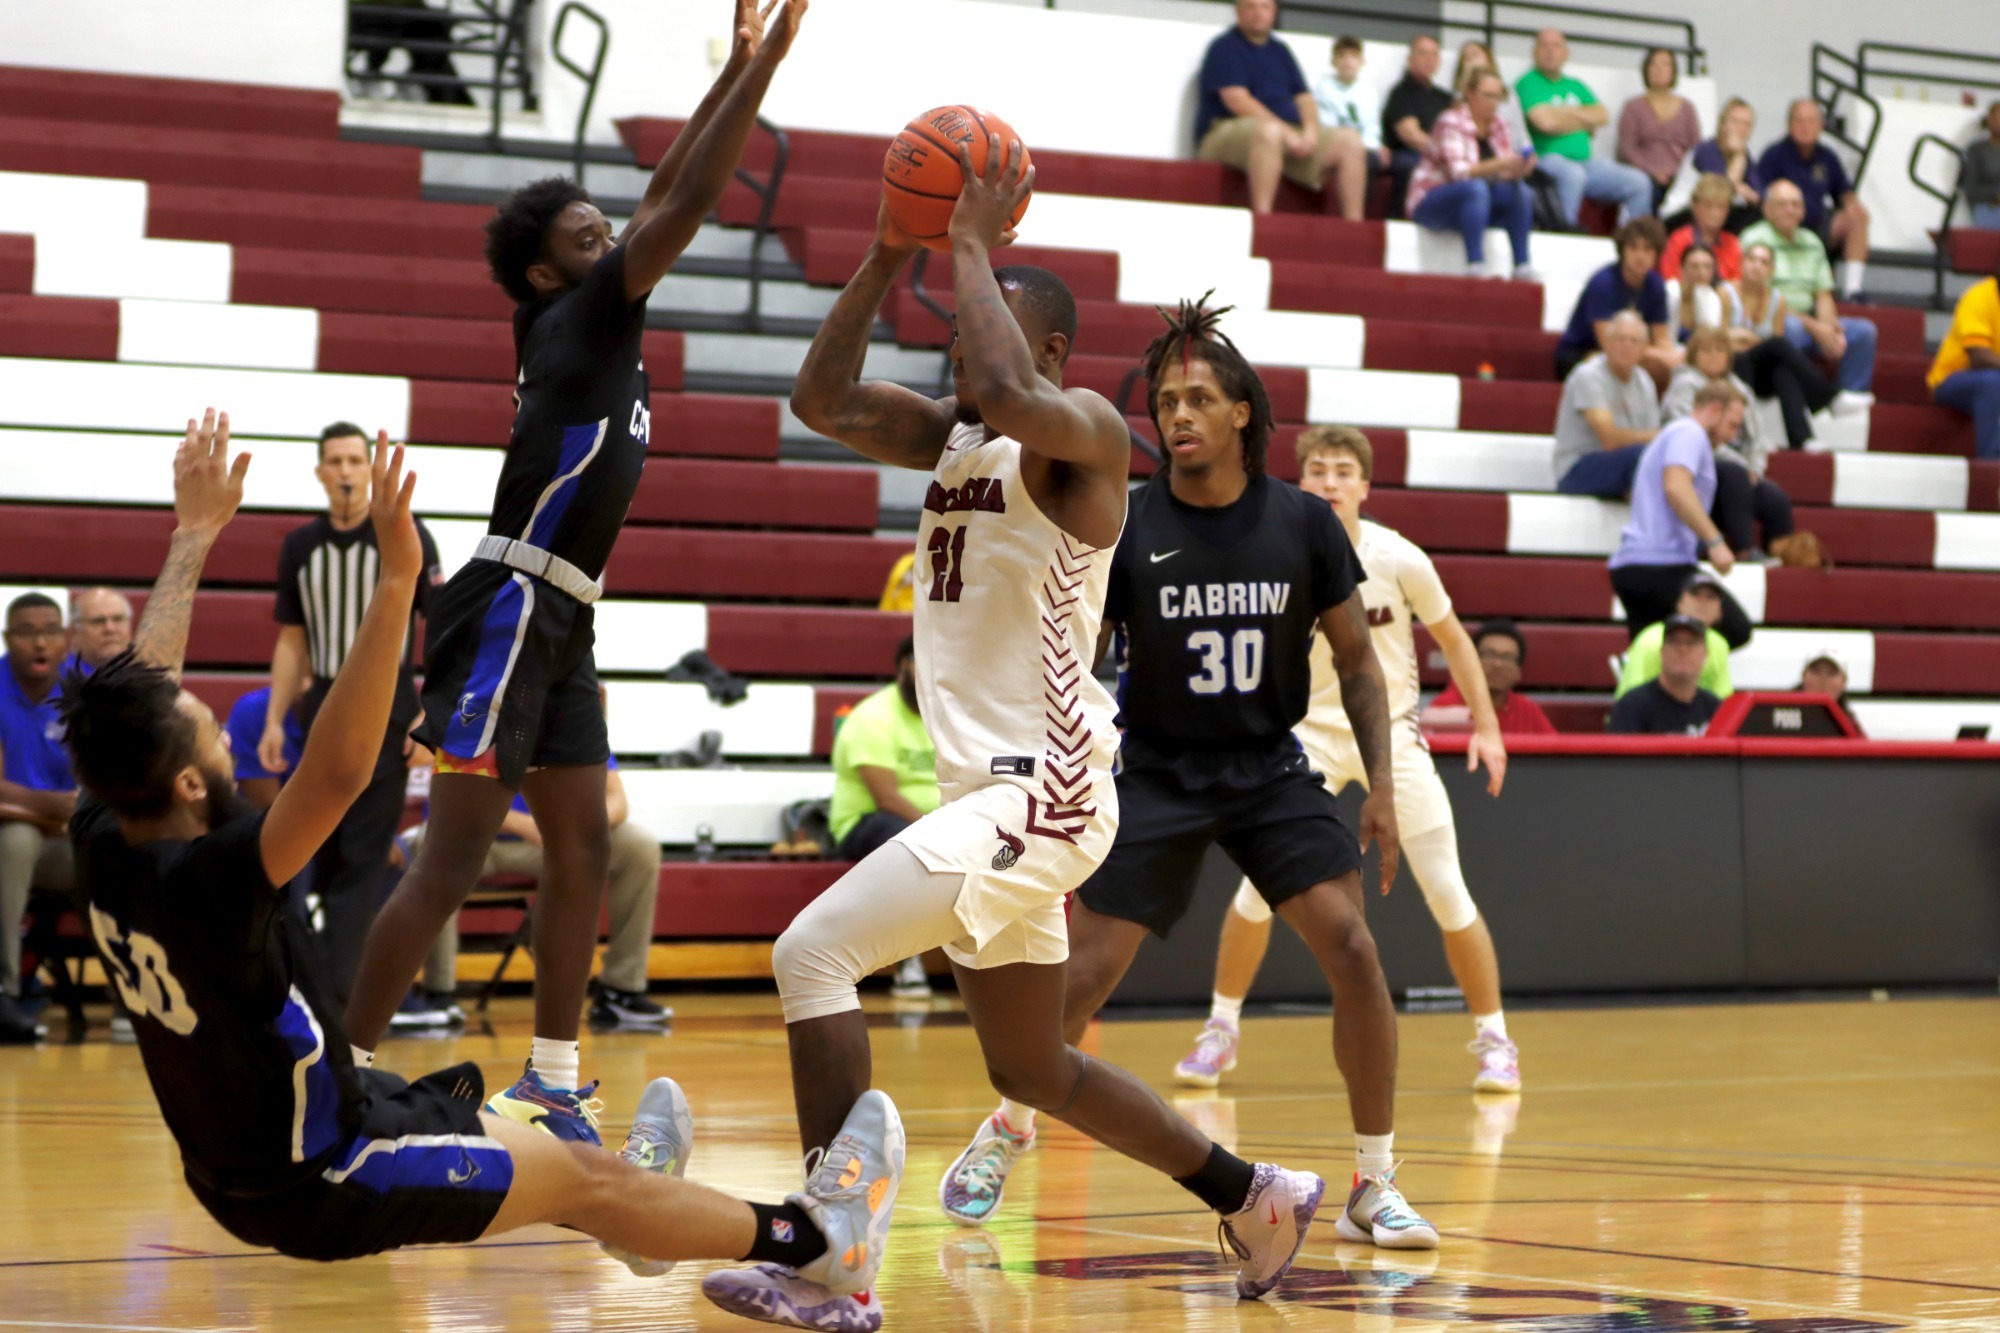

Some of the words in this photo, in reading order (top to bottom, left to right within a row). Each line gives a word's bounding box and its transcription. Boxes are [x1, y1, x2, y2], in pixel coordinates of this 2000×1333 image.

[927, 525, 968, 603] 21
[1159, 582, 1291, 619] CABRINI
[1187, 629, 1264, 695] 30
